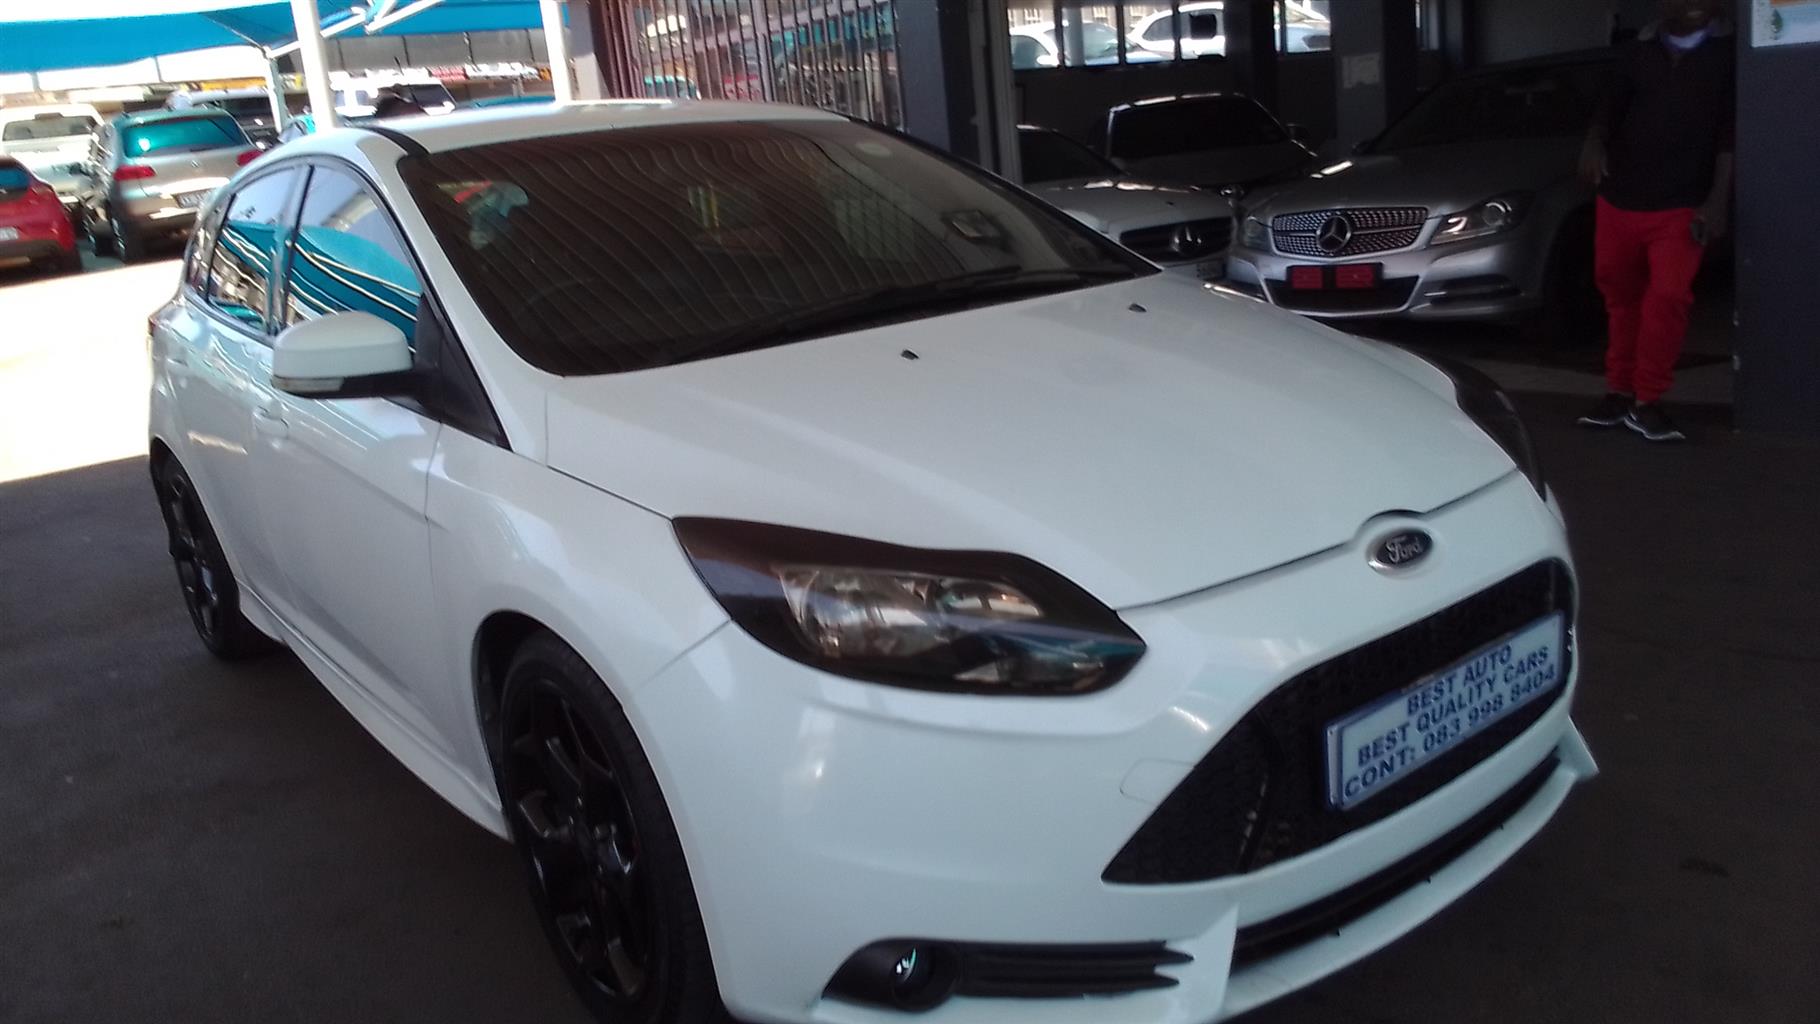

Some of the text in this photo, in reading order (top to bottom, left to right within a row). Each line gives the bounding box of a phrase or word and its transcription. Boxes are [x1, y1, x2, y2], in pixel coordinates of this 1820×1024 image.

[1385, 535, 1422, 562] Ford
[1358, 646, 1549, 767] BEST QUALITY CARS
[1408, 645, 1512, 716] BEST AUTO
[1344, 663, 1555, 797] CONT: 083 998 8404
